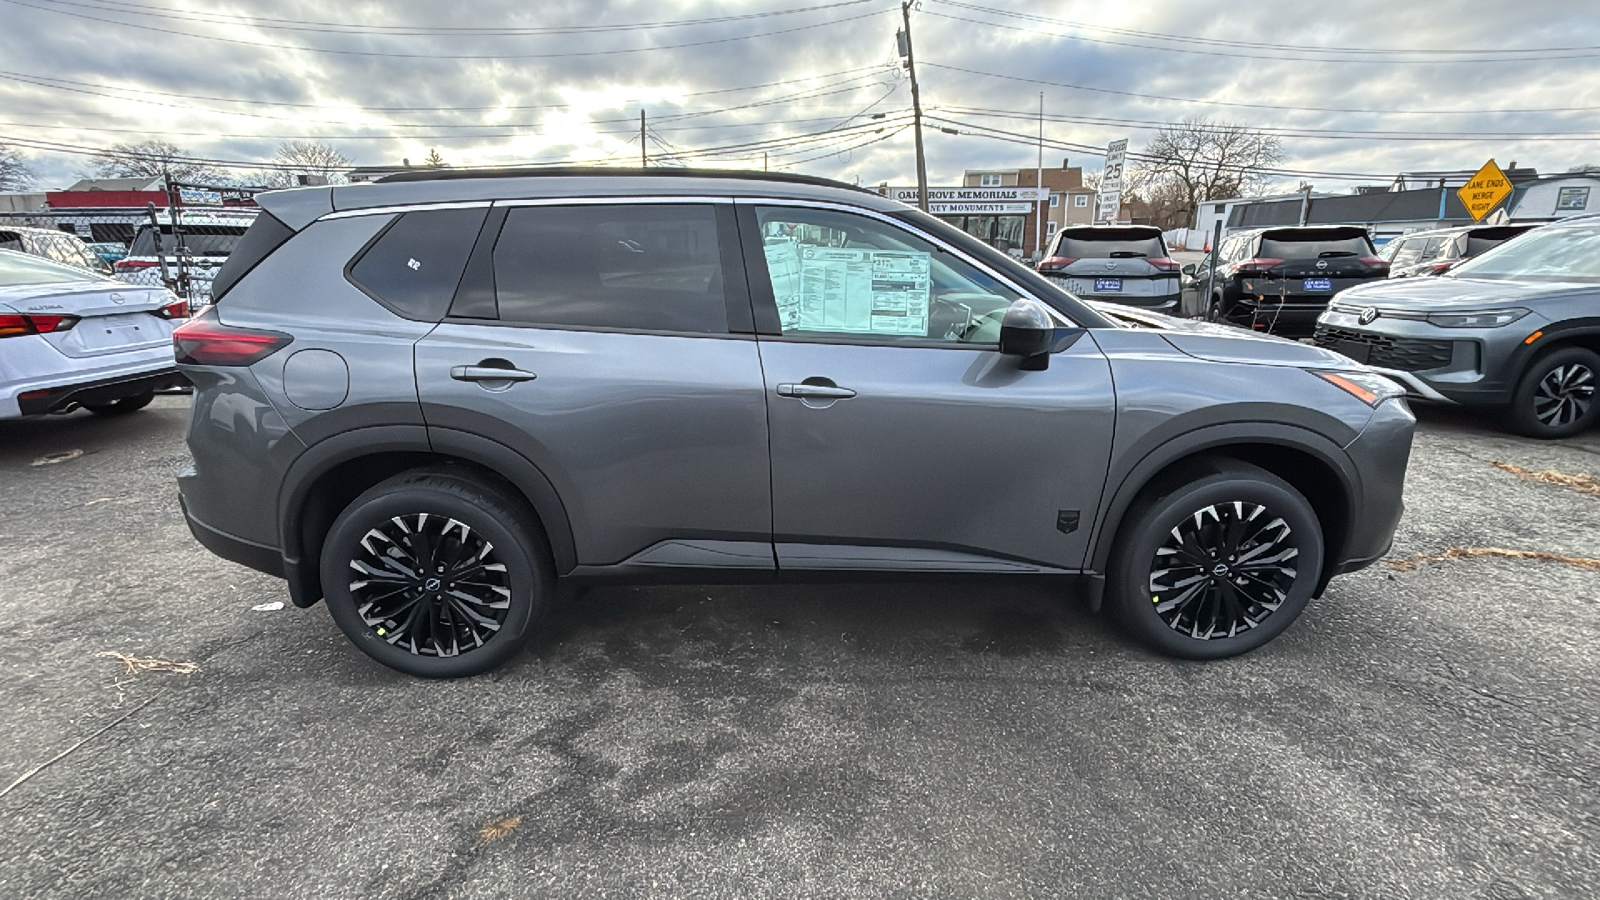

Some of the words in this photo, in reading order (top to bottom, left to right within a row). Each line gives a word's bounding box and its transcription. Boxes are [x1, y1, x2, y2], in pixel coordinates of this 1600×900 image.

[1108, 143, 1126, 152] SPEED
[1108, 152, 1123, 161] LIMIT
[1104, 163, 1122, 180] 25
[1467, 181, 1484, 189] LANE
[1486, 179, 1504, 188] ENDS
[957, 191, 1018, 199] MEMORIALS
[1472, 191, 1494, 200] MERGE
[949, 204, 1004, 212] MONUMENTS
[1471, 203, 1490, 211] RIGHT
